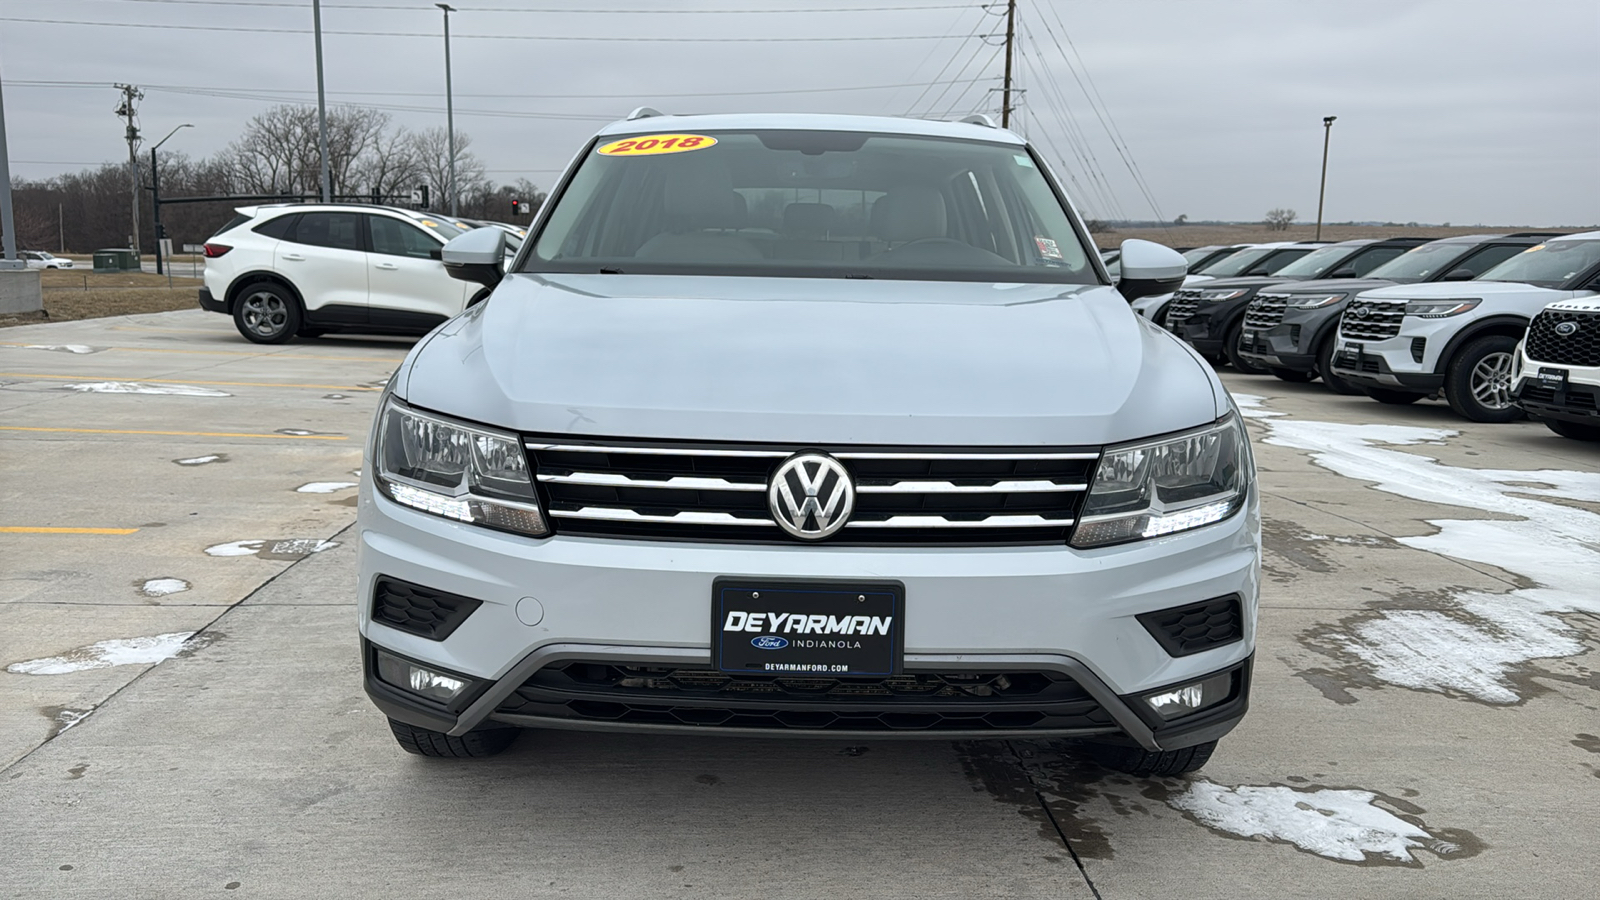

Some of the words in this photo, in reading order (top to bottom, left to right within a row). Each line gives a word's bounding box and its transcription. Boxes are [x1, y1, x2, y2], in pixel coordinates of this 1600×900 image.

[609, 137, 704, 154] 2018
[770, 454, 853, 539] VW
[723, 611, 892, 636] DEYARMAN
[792, 639, 861, 649] INDIANOLA
[765, 662, 849, 672] DEYARMANFORD.COM
